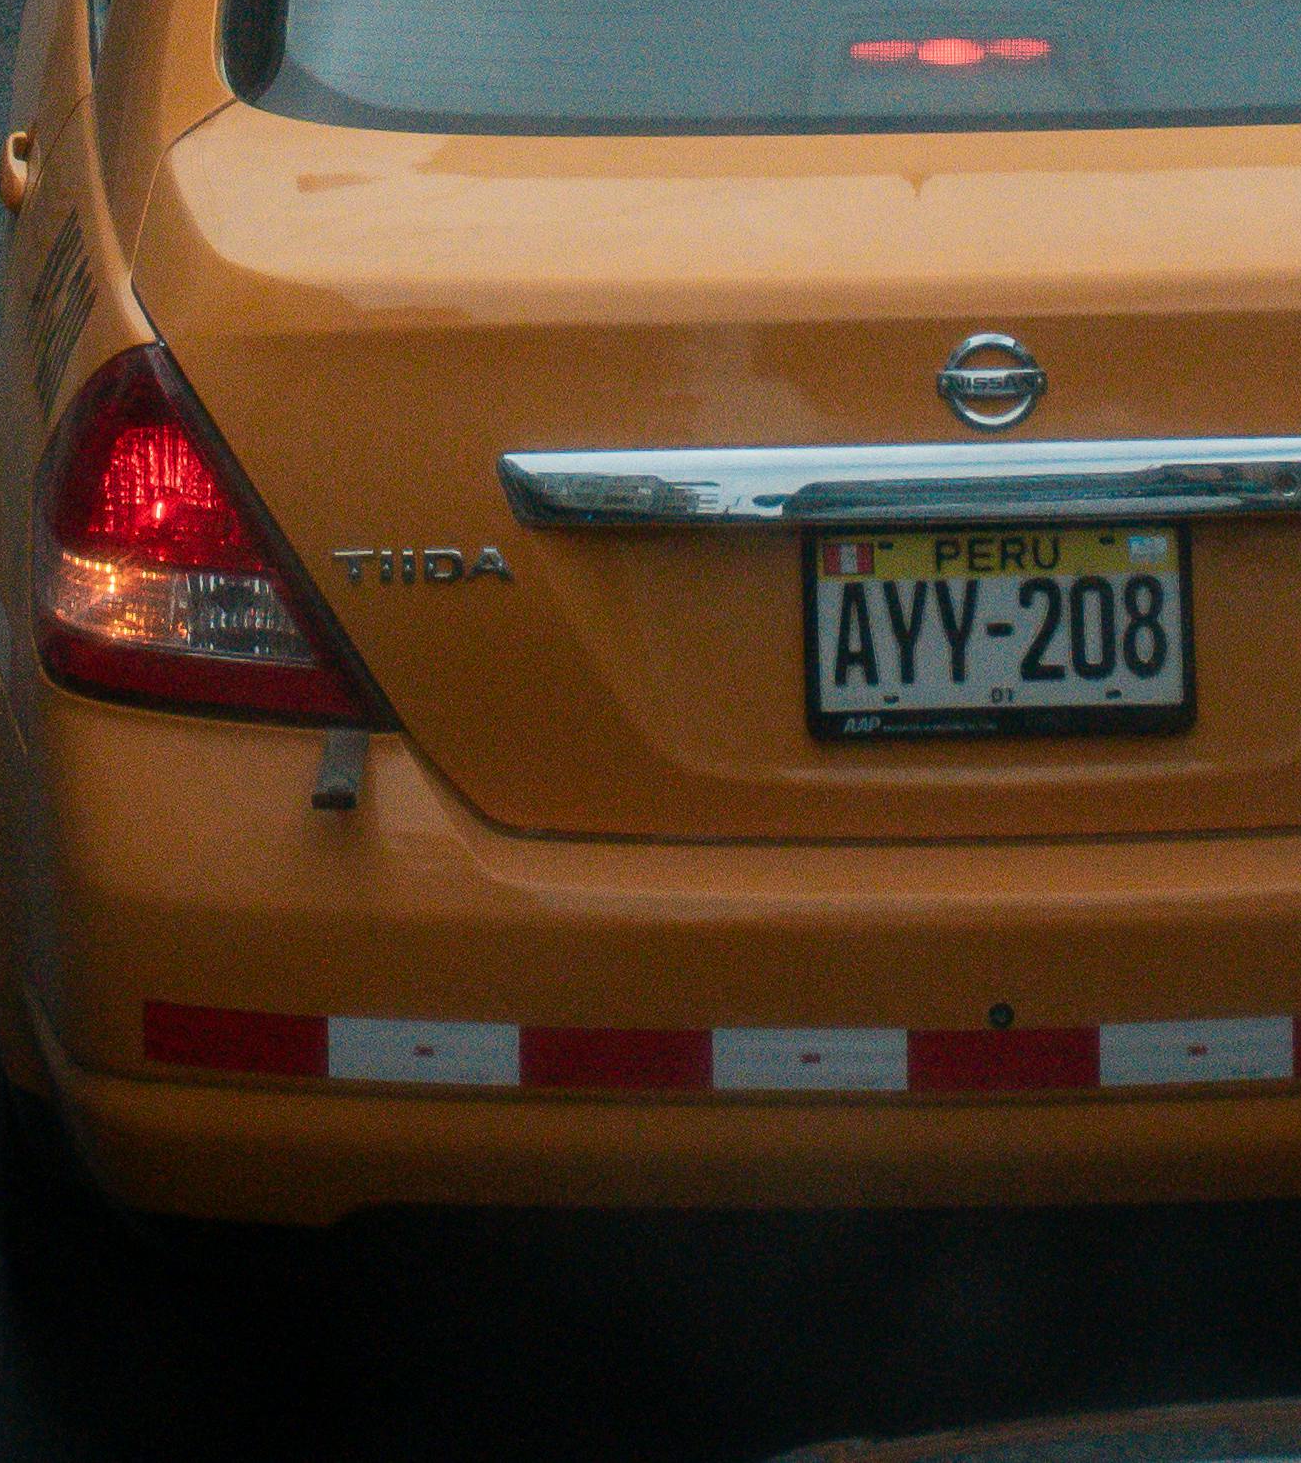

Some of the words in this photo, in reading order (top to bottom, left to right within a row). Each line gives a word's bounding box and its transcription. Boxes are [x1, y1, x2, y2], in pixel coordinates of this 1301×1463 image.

[948, 373, 1038, 394] NISSAN
[332, 546, 515, 585] TIIDA
[934, 536, 1062, 574] PERU
[833, 575, 1170, 688] AYY-208
